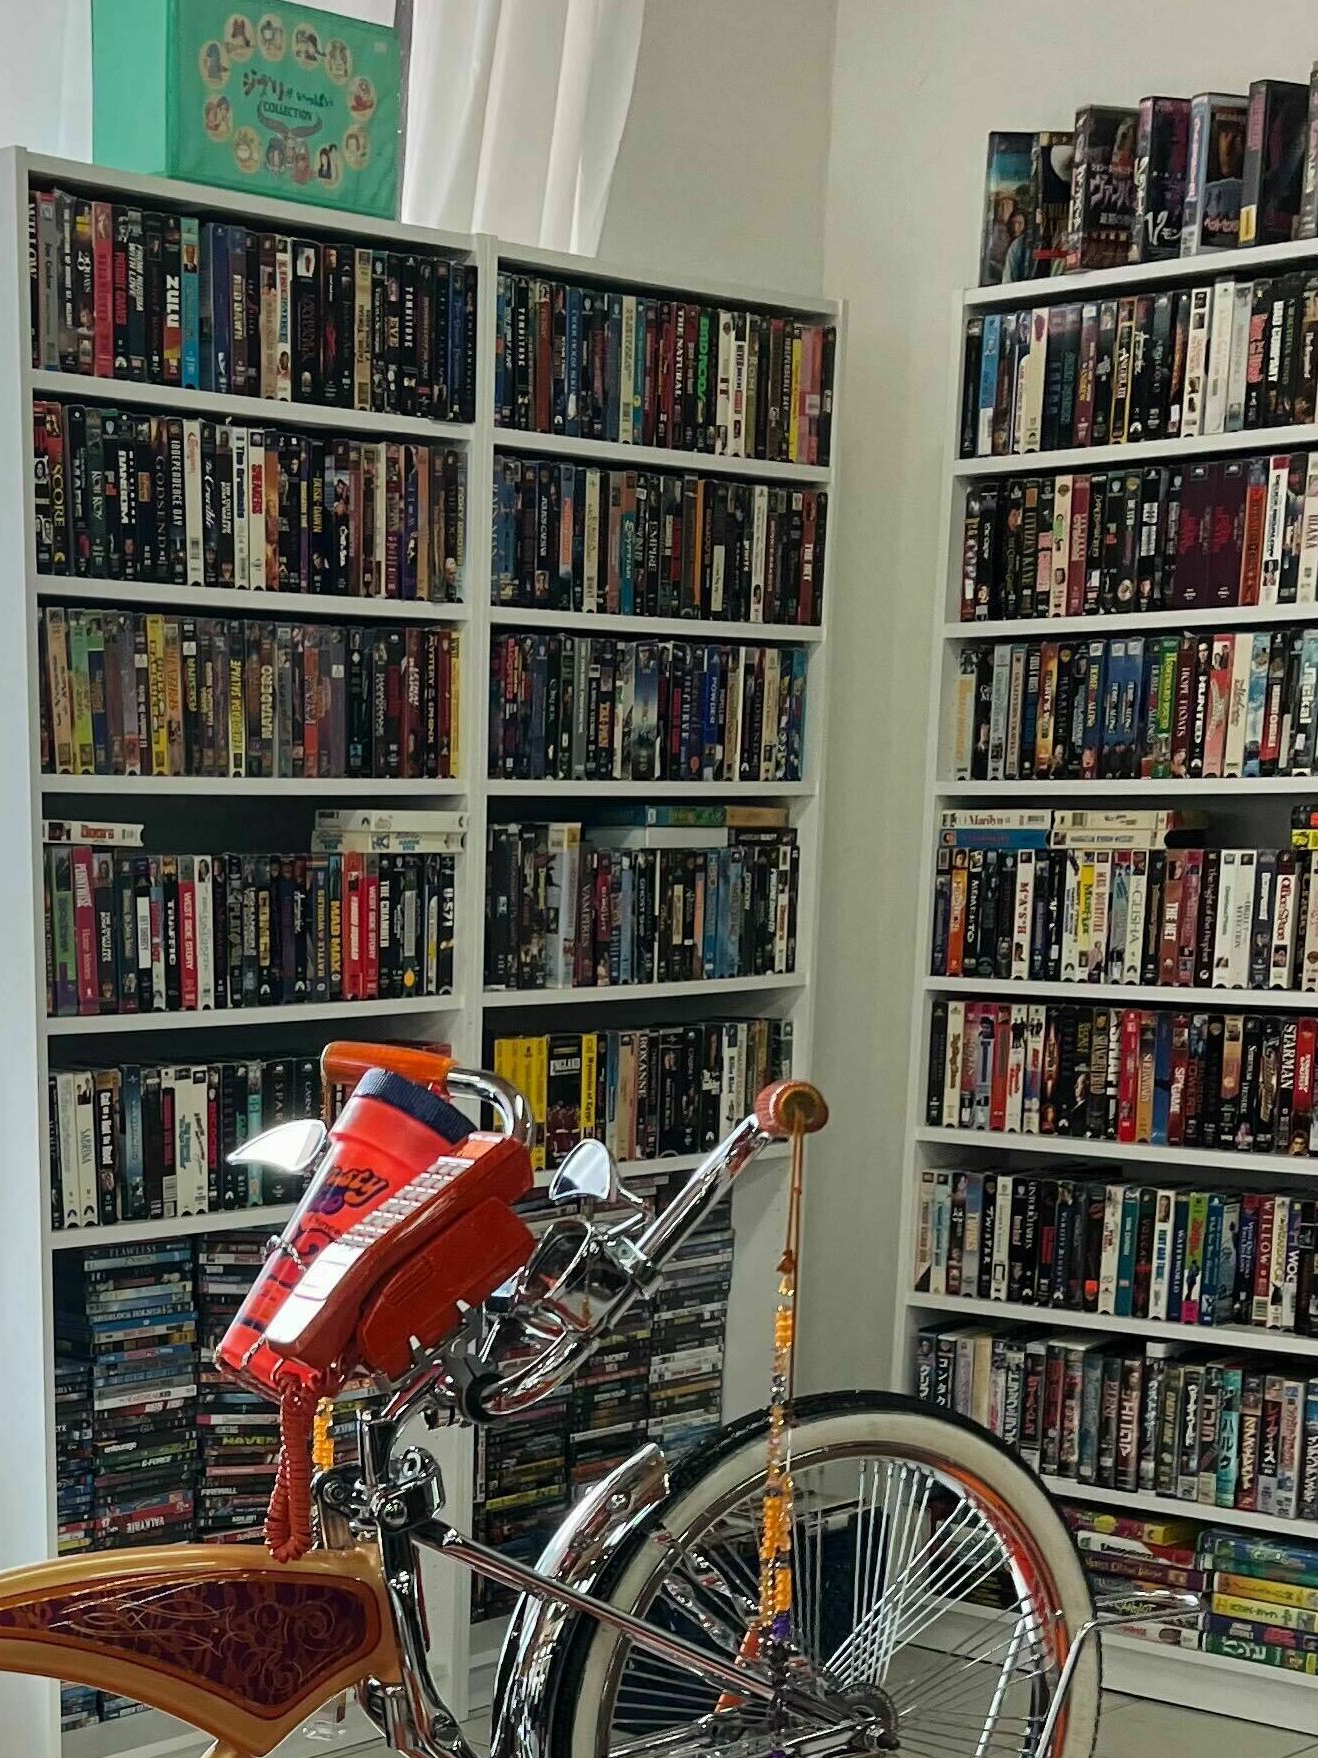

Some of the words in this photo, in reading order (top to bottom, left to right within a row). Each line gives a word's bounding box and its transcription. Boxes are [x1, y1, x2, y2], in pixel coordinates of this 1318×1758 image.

[263, 101, 313, 120] COLLECTION
[77, 250, 91, 271] 28
[115, 252, 126, 288] PATRIOT
[135, 244, 143, 274] FROM
[83, 271, 91, 293] DAYS
[136, 275, 144, 312] RUSSIA
[233, 274, 243, 301] RED
[116, 291, 127, 325] GAMES
[166, 274, 179, 328] ZULU
[1272, 300, 1284, 326] BAD
[234, 303, 244, 340] DAWN
[387, 316, 399, 347] EVE
[676, 309, 684, 336] THE
[1285, 306, 1295, 355] BEAUTIFUL
[674, 339, 684, 398] NATURAL
[1267, 327, 1282, 382] COMPANY
[747, 356, 756, 397] ROME
[170, 440, 183, 506] INDEPENDENCE
[236, 446, 245, 465] The
[52, 463, 65, 527] SCORE
[91, 471, 102, 494] ROB
[236, 468, 245, 519] Graduate
[251, 464, 263, 514] SNEAKERS
[312, 477, 323, 502] DUSK
[92, 496, 103, 521] ROY
[155, 455, 167, 548] GODSEND
[173, 508, 183, 526] DAY
[204, 476, 215, 529] Crucible
[312, 506, 323, 533] DAWN
[1024, 512, 1036, 554] CITIZEN
[648, 521, 658, 572] EMPIRE
[1022, 557, 1035, 587] KANE
[229, 660, 242, 698] SALVAJE
[1089, 664, 1099, 690] HOME
[1180, 667, 1191, 696] HOPE
[1299, 662, 1317, 724] Jackal
[260, 665, 273, 739] MATADERO
[681, 694, 690, 740] CURVE
[709, 676, 718, 724] POWDER
[1194, 675, 1207, 744] HUNTED
[230, 699, 243, 752] TEMPORADA
[1176, 700, 1190, 737] FLOATS
[379, 880, 390, 898] THE
[1207, 868, 1216, 883] The
[1279, 877, 1292, 909] Office
[183, 892, 193, 917] WEST
[368, 886, 376, 907] WEST
[442, 888, 453, 927] U-571
[1165, 901, 1179, 921] THE
[1204, 884, 1215, 905] Night
[1206, 906, 1213, 914] of
[184, 919, 193, 939] SIDE
[330, 900, 340, 936] MAD
[368, 910, 376, 931] SIDE
[380, 900, 389, 948] CHAMBER
[581, 884, 592, 948] VAMPIRES
[1129, 889, 1142, 944] GEISHA
[1163, 923, 1178, 941] NET
[1204, 915, 1212, 930] the
[1276, 908, 1290, 940] Space
[185, 941, 194, 970] STORY
[331, 938, 341, 974] MAX
[368, 934, 376, 959] STORY
[1200, 930, 1212, 962] Prophet
[637, 1036, 649, 1098] ROXANNE
[1106, 1026, 1121, 1096] SHAFT
[1280, 1023, 1297, 1090] STARMAN
[1174, 1067, 1185, 1088] SPY
[1186, 1057, 1198, 1116] TOWERS
[584, 1101, 594, 1123] Egypt
[1170, 1083, 1182, 1115] GAME
[80, 1128, 92, 1165] SABRINA
[1025, 1182, 1036, 1249] UNTOUCHABLES
[1059, 1211, 1067, 1246] VARSITY
[1260, 1200, 1274, 1264] WILLOW
[983, 1206, 994, 1264] TWISTER
[1173, 1229, 1185, 1294] WATERWORLD
[1164, 1391, 1176, 1422] ENEMY
[1162, 1422, 1175, 1445] MINE
